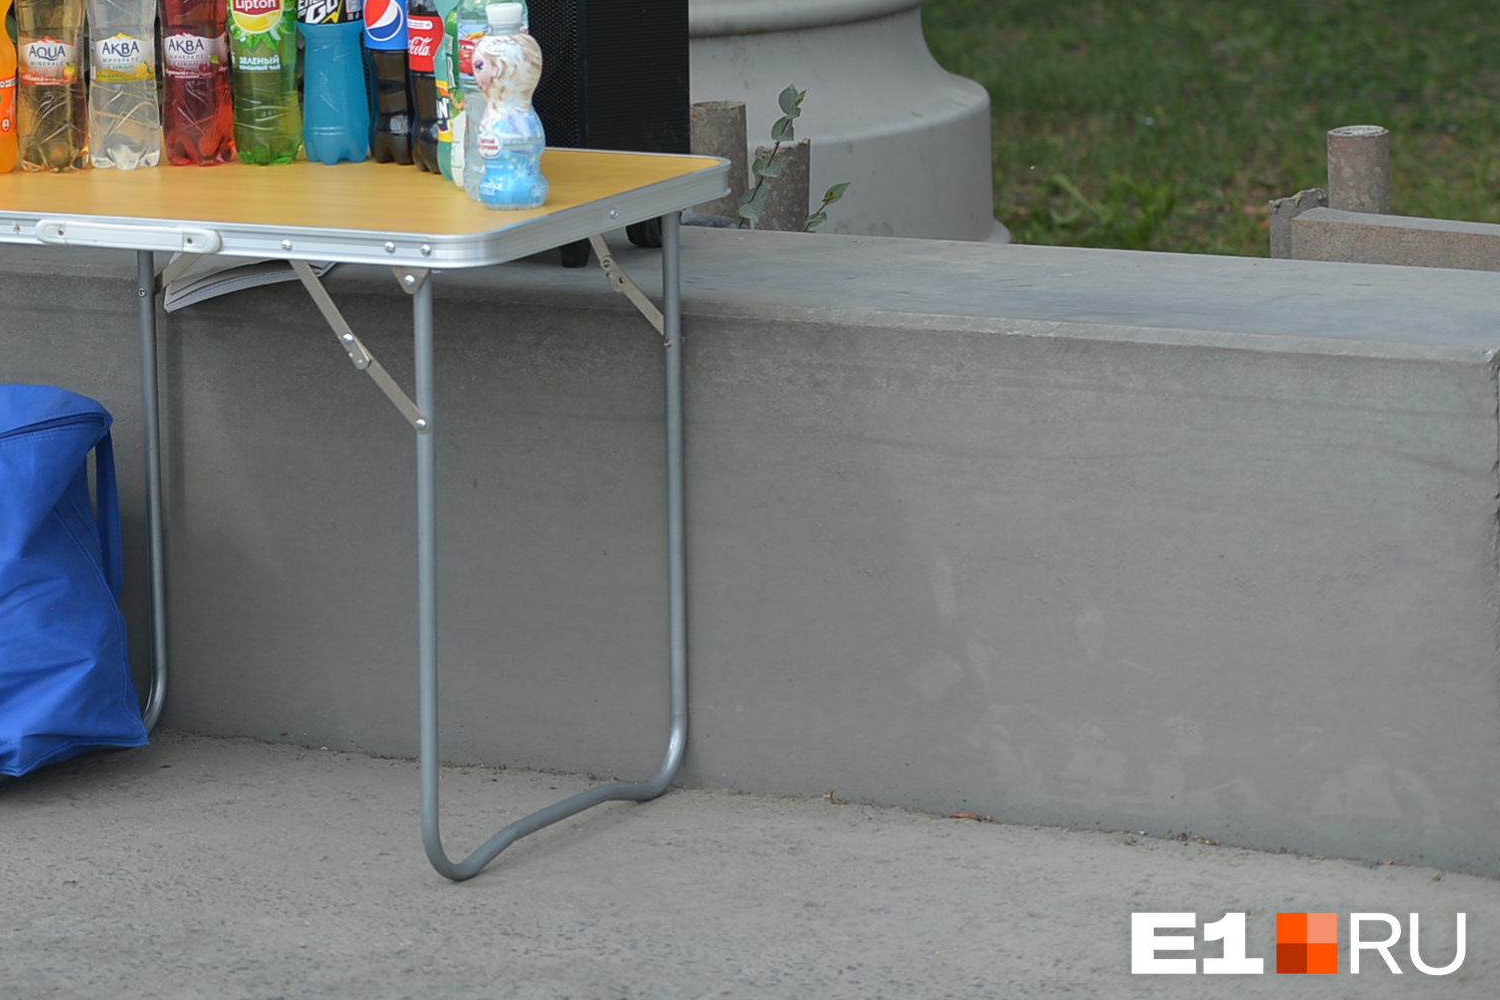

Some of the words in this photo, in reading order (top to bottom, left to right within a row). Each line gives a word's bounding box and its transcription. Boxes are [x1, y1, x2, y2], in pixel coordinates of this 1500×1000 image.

[28, 44, 66, 61] AQUA
[101, 40, 140, 58] АКВА
[168, 38, 205, 55] АКВА
